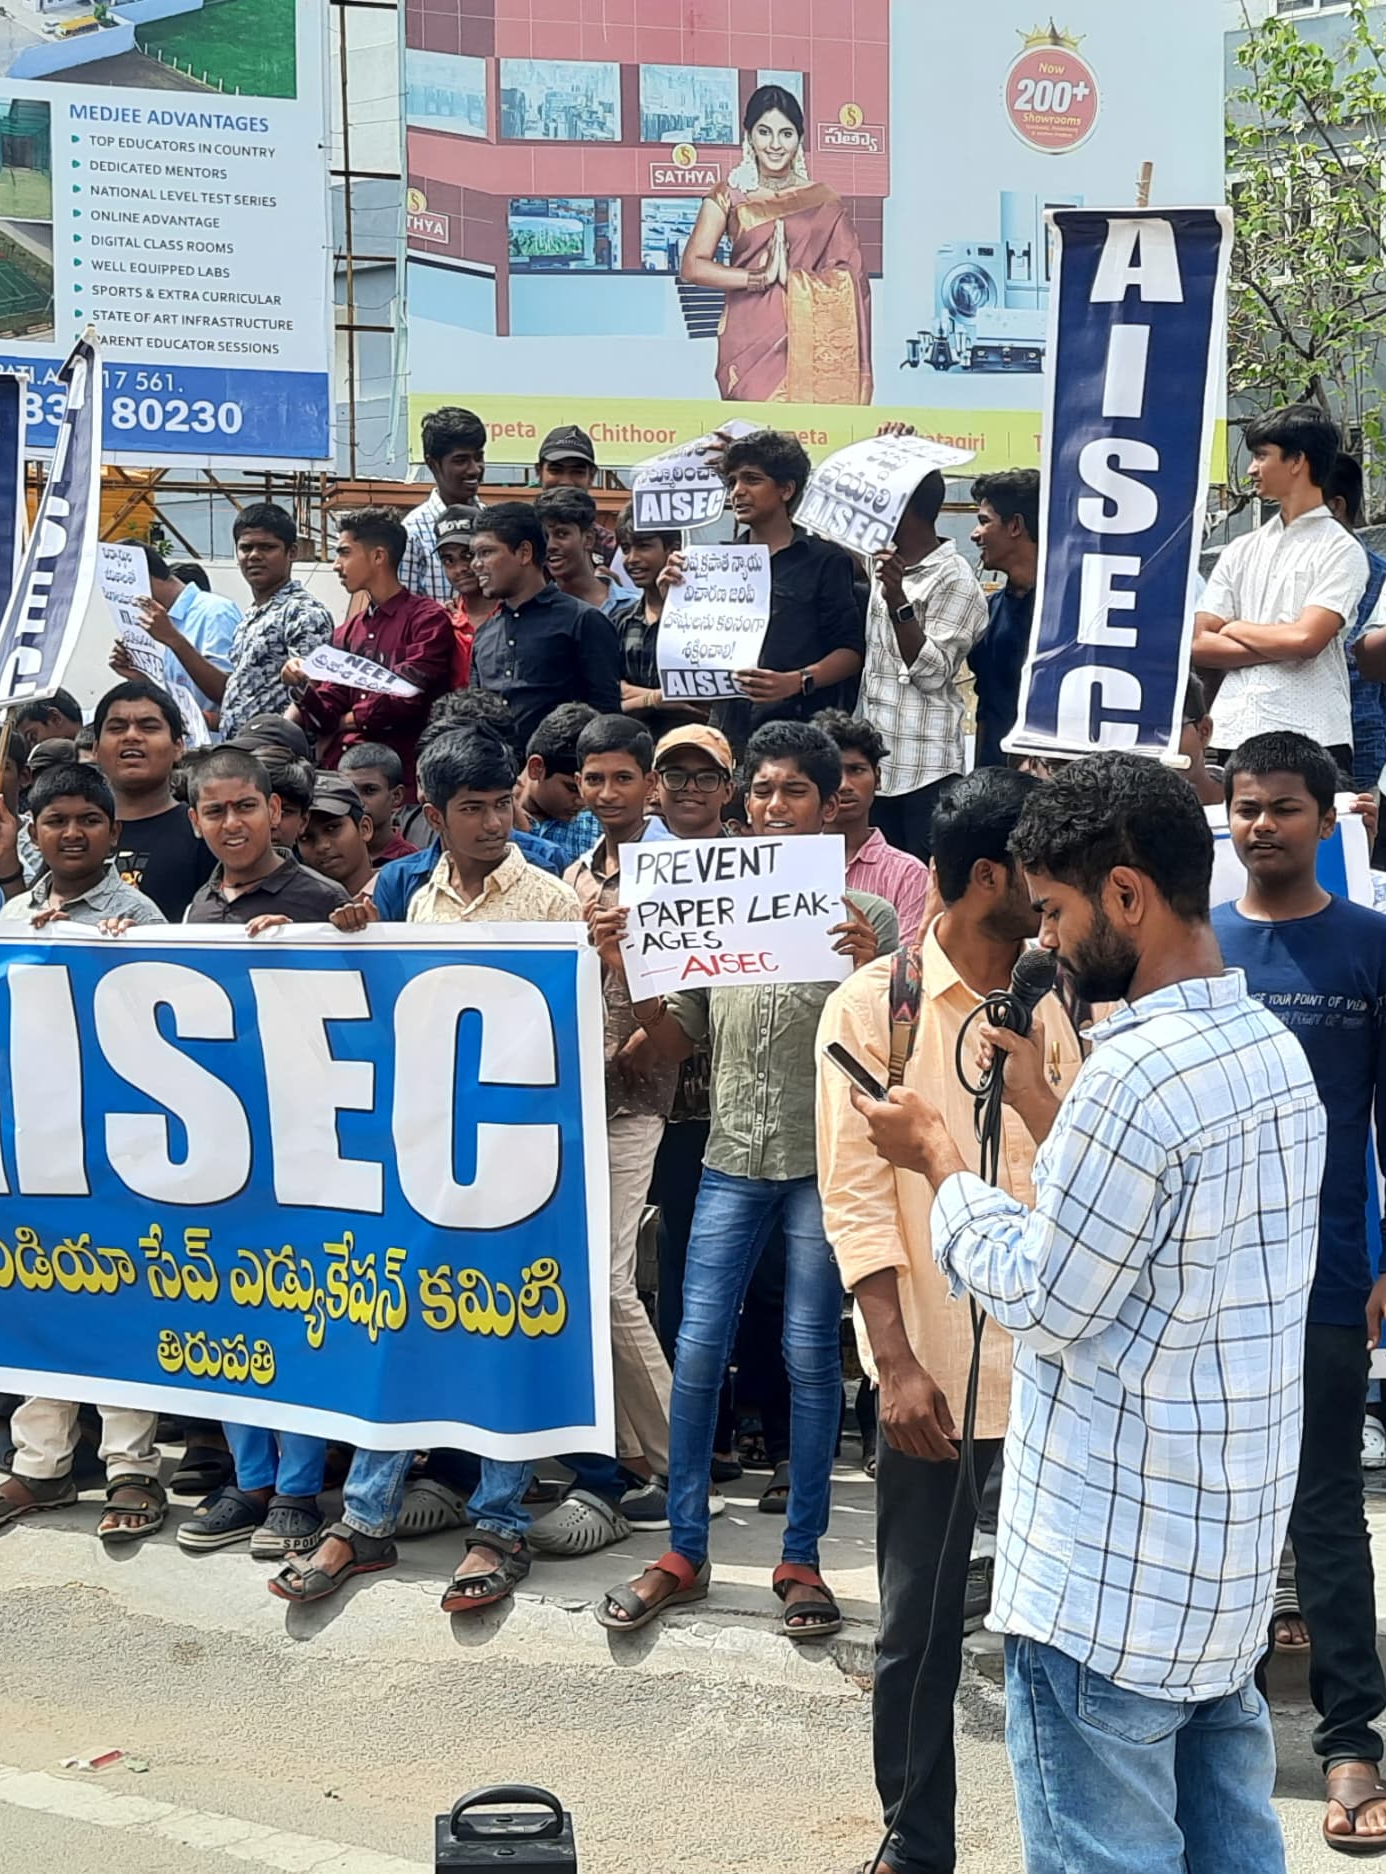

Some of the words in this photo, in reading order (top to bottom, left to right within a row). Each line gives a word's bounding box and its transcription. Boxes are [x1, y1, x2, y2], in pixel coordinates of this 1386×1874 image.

[1039, 63, 1065, 74] Now
[1014, 79, 1090, 113] 200+
[70, 104, 142, 123] MEDJEE
[147, 110, 269, 132] ADVANTAGES
[1023, 112, 1081, 126] Showrooms
[89, 135, 115, 147] TOP
[118, 137, 195, 153] EDUCATORS
[198, 142, 212, 154] IN
[214, 144, 276, 158] COUNTRY
[823, 128, 878, 153] సత్యా
[90, 160, 162, 175] DEDICATED
[165, 165, 227, 180] MENTORS
[654, 169, 716, 185] SATHYA
[90, 185, 157, 200] NATIONAL
[160, 190, 199, 202] LEVEL
[200, 192, 231, 205] TEST
[234, 194, 277, 208] SERIES
[90, 210, 140, 224] ONLINE
[142, 213, 220, 228] ADVANTAGE
[91, 235, 141, 249] DIGITAL
[144, 238, 184, 251] CLASS
[187, 242, 234, 254] ROOMS
[91, 260, 127, 272] WELL
[130, 262, 195, 276] EQUIPPED
[198, 267, 230, 278] LABS
[92, 285, 143, 298] SPORTS
[145, 288, 154, 299] &
[158, 289, 199, 302] EXTRA
[202, 292, 281, 306] CURRICULAR
[92, 310, 131, 322] STATE
[134, 312, 150, 323] OF
[153, 314, 178, 325] ART
[182, 315, 293, 331] INFRASTRUCTURE
[146, 338, 216, 351] EDUCATOR
[218, 342, 280, 354] SESSIONS
[135, 374, 183, 394] 561.
[113, 397, 243, 434] 80230
[589, 422, 677, 444] Chithoor
[1057, 219, 1184, 749] AISEC
[640, 489, 724, 522] AISEC
[437, 519, 471, 536] BOYS
[803, 493, 889, 554] AISEC
[635, 843, 783, 885] PREVENT
[637, 897, 734, 928] PAPER
[747, 891, 840, 924] LEAK-
[681, 952, 780, 981] AISEC
[1269, 993, 1292, 1006] YOUR
[1293, 993, 1323, 1007] POINT
[1328, 996, 1344, 1008] OF
[139, 1223, 218, 1306] సేవ్
[231, 1231, 407, 1350] ఎడ్యుకేషన్
[157, 1327, 276, 1385] తిరుపతి
